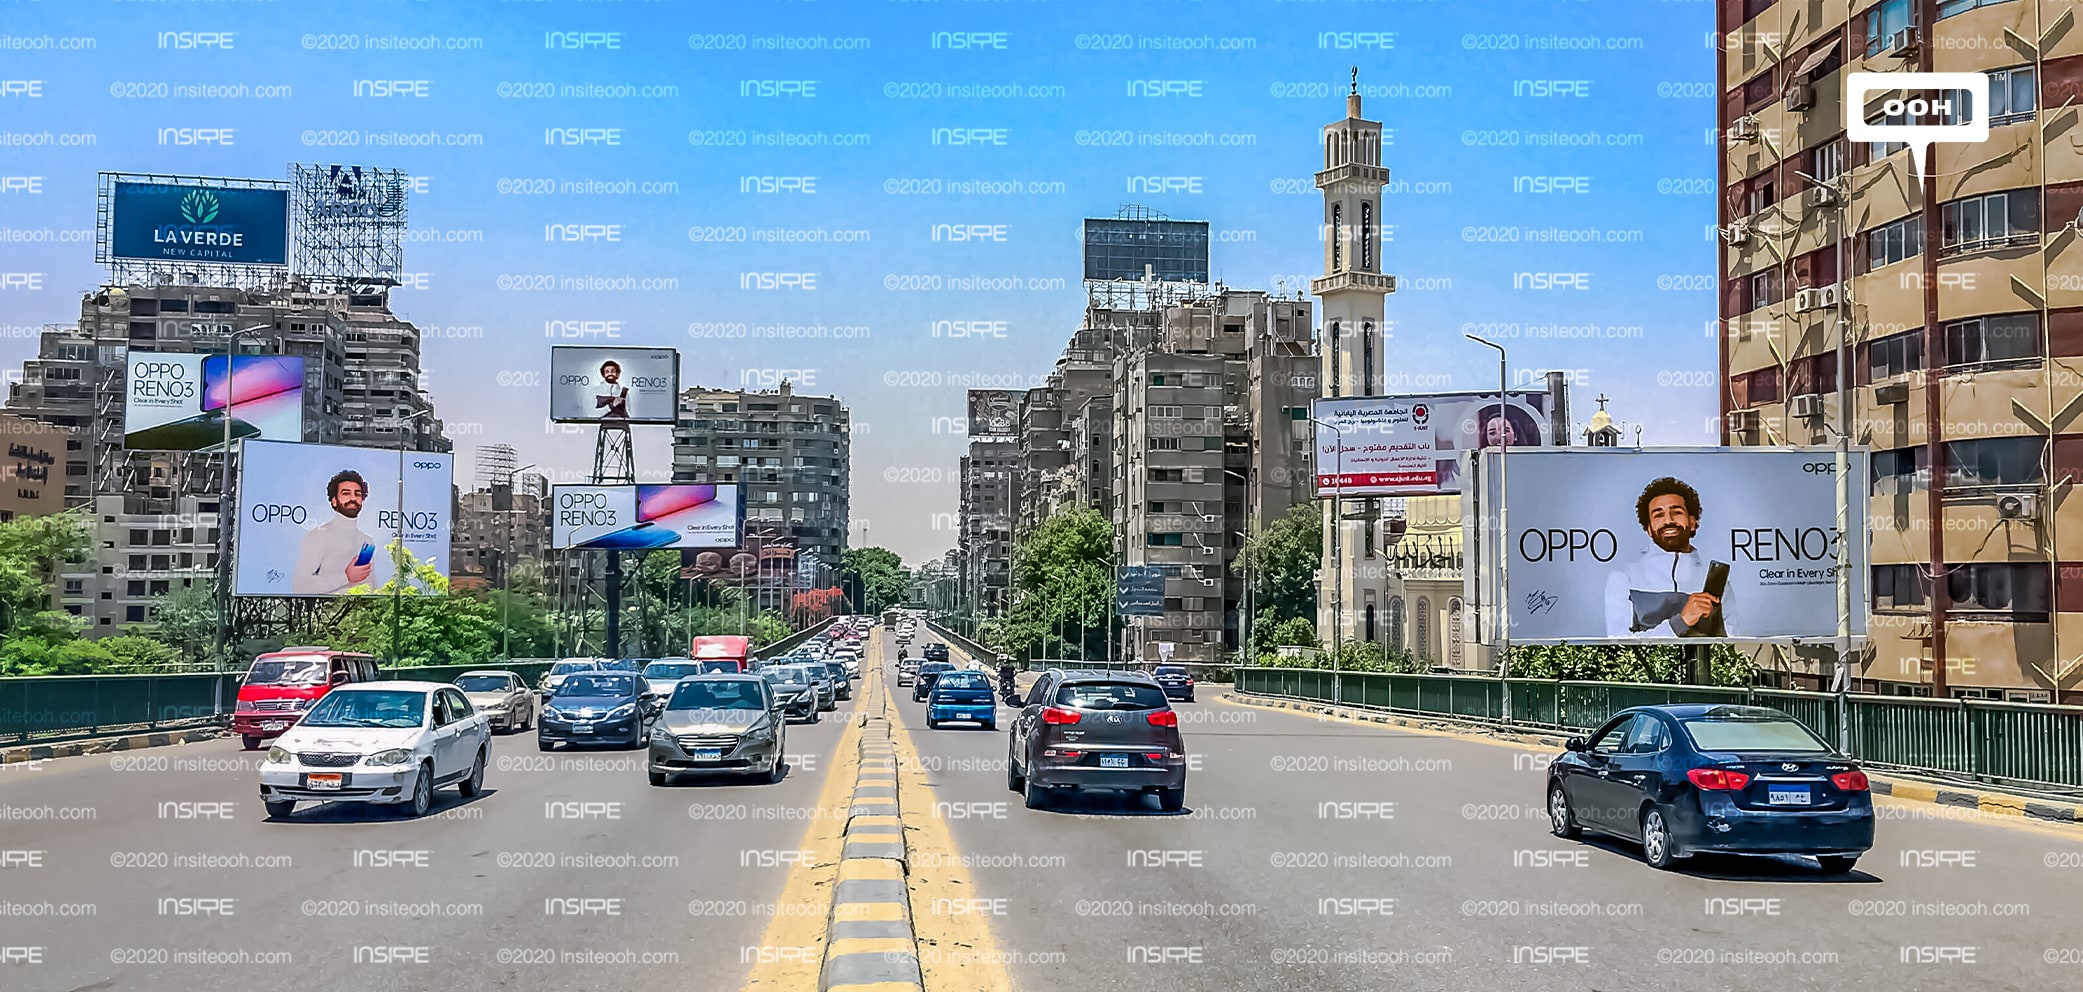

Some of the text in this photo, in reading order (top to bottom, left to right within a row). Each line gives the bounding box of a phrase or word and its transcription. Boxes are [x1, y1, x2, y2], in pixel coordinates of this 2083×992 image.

[154, 229, 243, 247] LA VERDE
[163, 248, 233, 258] NEW CAPITAL
[135, 362, 184, 379] OPPO
[560, 375, 590, 386] OPPO
[631, 376, 667, 388] RENO3
[134, 380, 194, 398] RENO3
[413, 461, 441, 470] oppo
[1803, 462, 1850, 476] opp
[560, 493, 607, 509] OPPO
[252, 504, 307, 525] OPPO
[378, 510, 438, 530] RENO3
[560, 510, 617, 526] RENO3
[1519, 528, 1617, 562] OPPO
[1731, 527, 1839, 561] RENO3
[1759, 569, 1785, 579] Clear
[1786, 568, 1795, 578] in
[1797, 569, 1825, 579] Every
